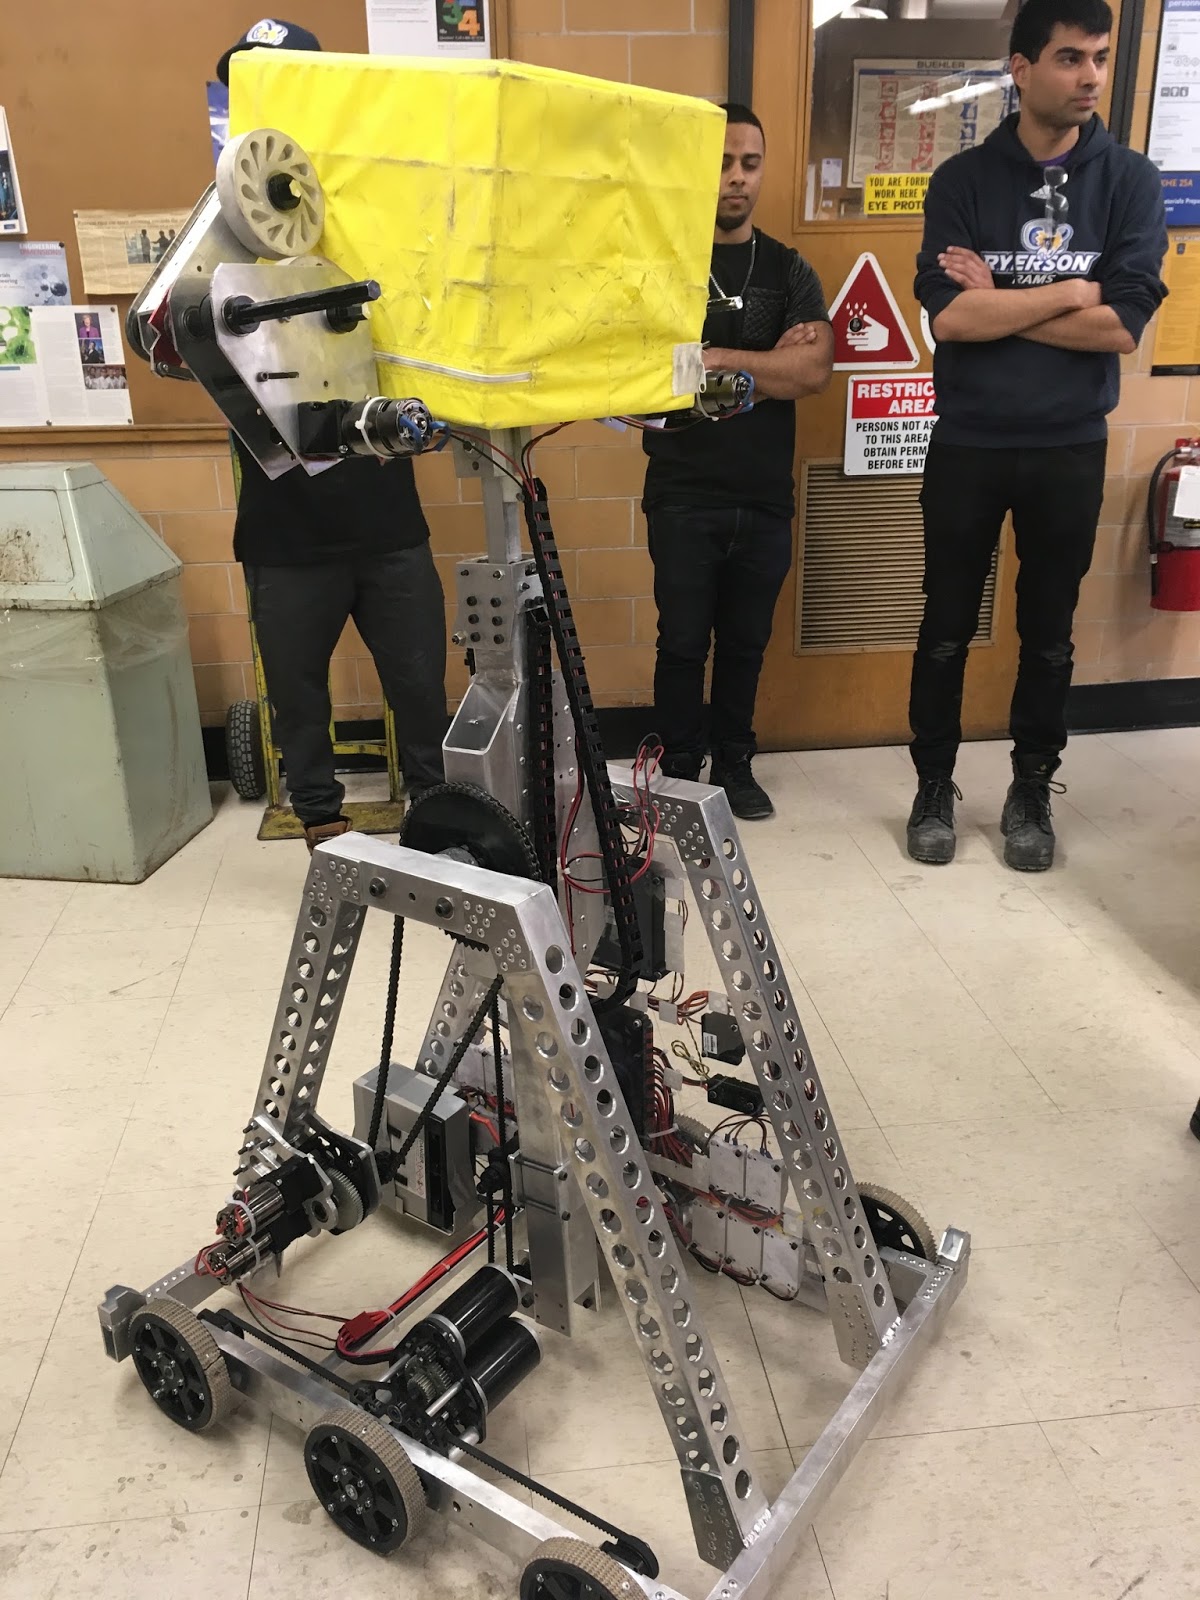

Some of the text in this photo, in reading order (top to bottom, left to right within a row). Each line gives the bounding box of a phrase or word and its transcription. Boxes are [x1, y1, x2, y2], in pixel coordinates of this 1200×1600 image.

[916, 61, 965, 69] BUEHLER
[870, 176, 927, 187] YOU ARE FORBI
[875, 189, 896, 198] WORK
[900, 188, 917, 198] HERE
[868, 200, 924, 211] EYE PROT
[982, 253, 1096, 272] RYERSON
[1012, 274, 1056, 285] RAMS
[857, 381, 935, 399] RESTRIC
[888, 399, 936, 415] AREA
[856, 420, 935, 432] PERSONS NOT AS
[866, 433, 928, 444] TO THIS AREA
[864, 446, 927, 457] OBTAIN PERM
[868, 459, 924, 469] BEFORE ENT
